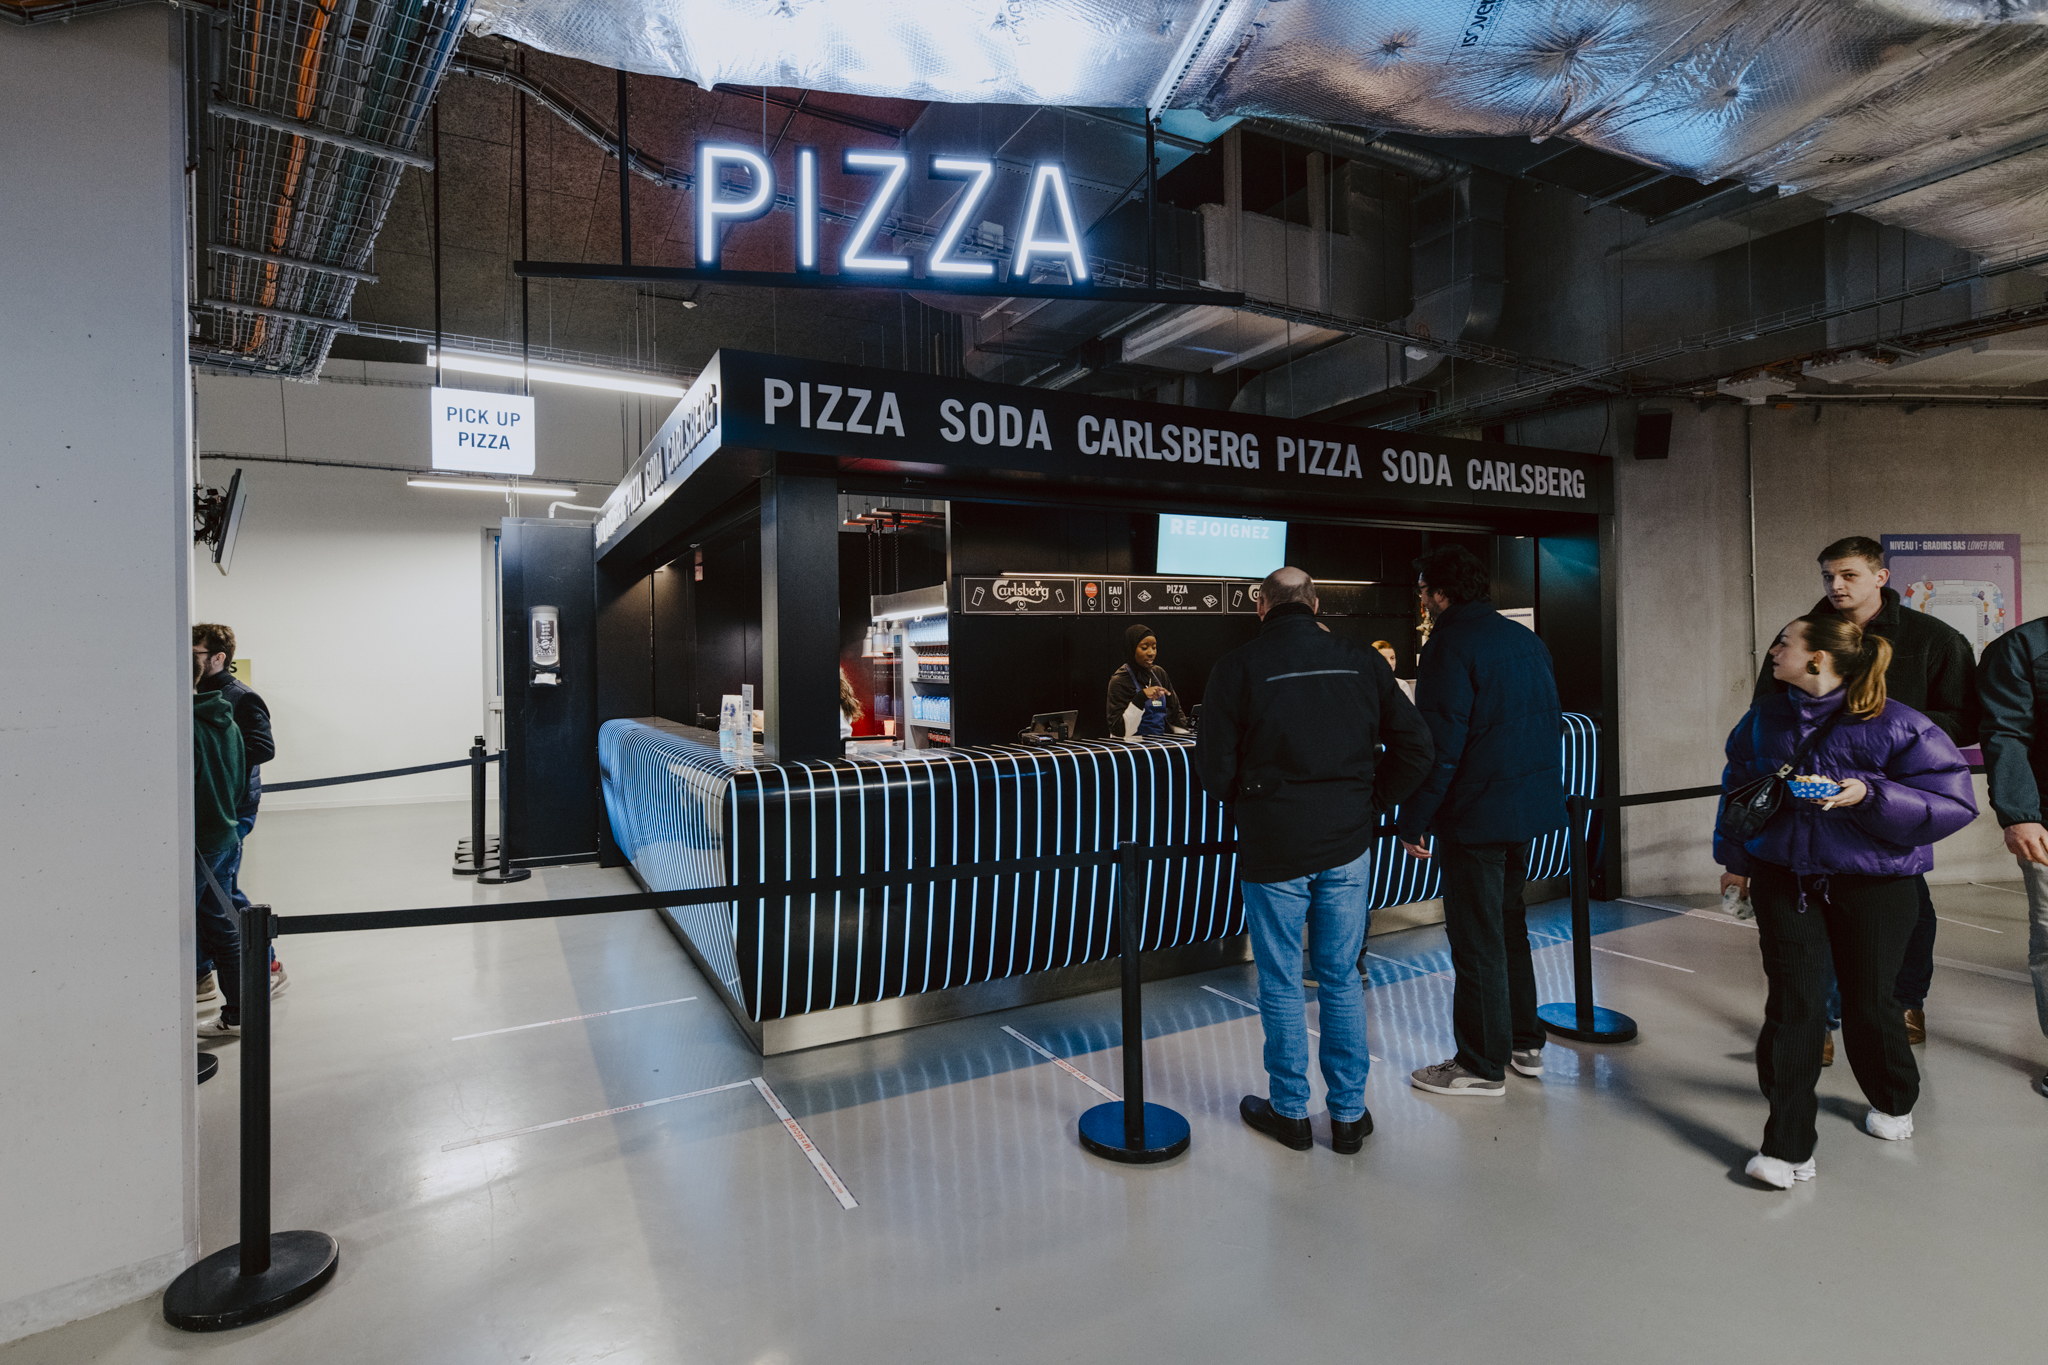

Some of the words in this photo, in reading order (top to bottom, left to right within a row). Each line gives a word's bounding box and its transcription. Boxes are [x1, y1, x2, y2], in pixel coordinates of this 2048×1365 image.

[701, 146, 1089, 280] PIZZA
[446, 406, 489, 425] PICK
[497, 411, 521, 427] UP
[666, 383, 718, 475] CARLSBERG
[763, 377, 905, 437] PIZZA
[939, 398, 1052, 451] SODA
[1077, 414, 1260, 470] CARLSBERG
[1276, 435, 1363, 479] PIZZA
[1382, 447, 1453, 487] SODA
[1467, 458, 1586, 498] CARLSBERG
[458, 431, 510, 450] PIZZA
[1170, 517, 1270, 540] REJOIGNEZ
[1889, 540, 1914, 551] NIVEAU
[1914, 541, 1918, 550] 1
[1922, 541, 1952, 551] GRADINS
[1952, 541, 1966, 551] BAS
[1967, 541, 1988, 551] LOWER
[1988, 541, 2005, 551] BOWL
[992, 579, 1050, 602] Carlsberg
[1108, 586, 1122, 595] EAU
[1166, 585, 1189, 594] PIZZA
